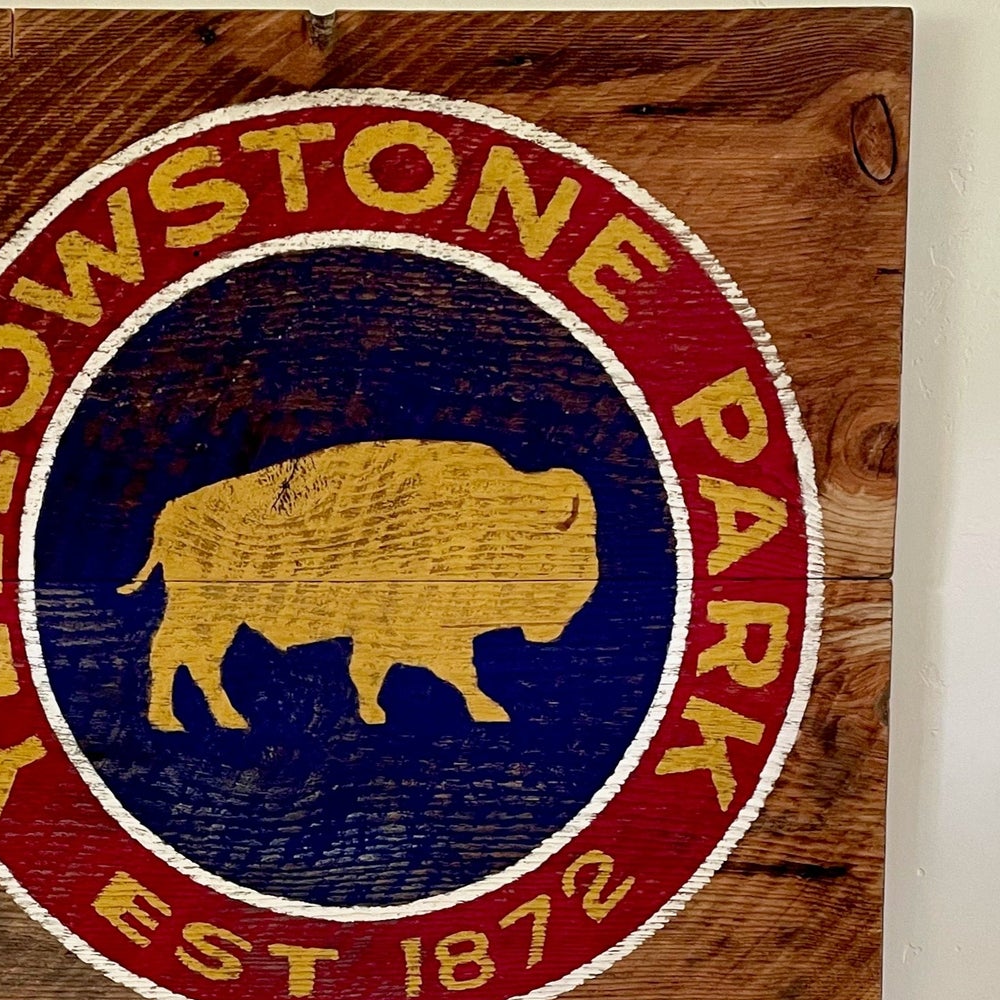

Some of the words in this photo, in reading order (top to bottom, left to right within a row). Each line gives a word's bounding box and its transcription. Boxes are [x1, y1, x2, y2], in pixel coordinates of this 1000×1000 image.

[657, 368, 788, 810] PARK
[92, 870, 338, 998] EST
[402, 849, 636, 998] 1872
